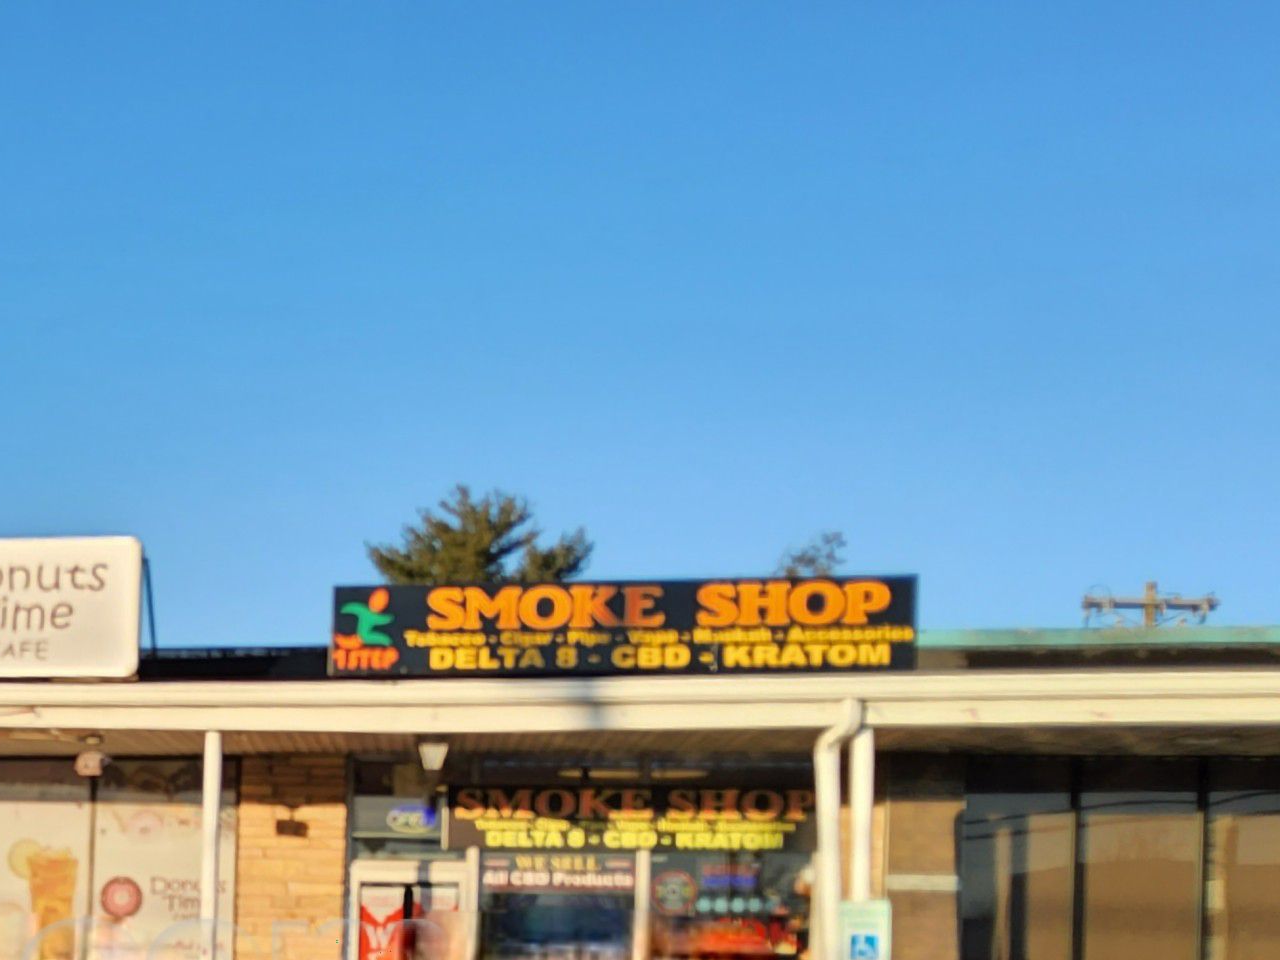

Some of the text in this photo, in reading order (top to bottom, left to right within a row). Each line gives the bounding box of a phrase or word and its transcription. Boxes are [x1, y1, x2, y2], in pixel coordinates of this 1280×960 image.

[426, 581, 891, 630] SMOKE SHOP
[429, 646, 546, 670] DELTA
[555, 646, 578, 669] 8
[611, 644, 691, 669] CBD
[723, 642, 892, 668] KRATOM
[455, 788, 816, 822] SMOKE SHOP
[485, 830, 564, 848] DELTA
